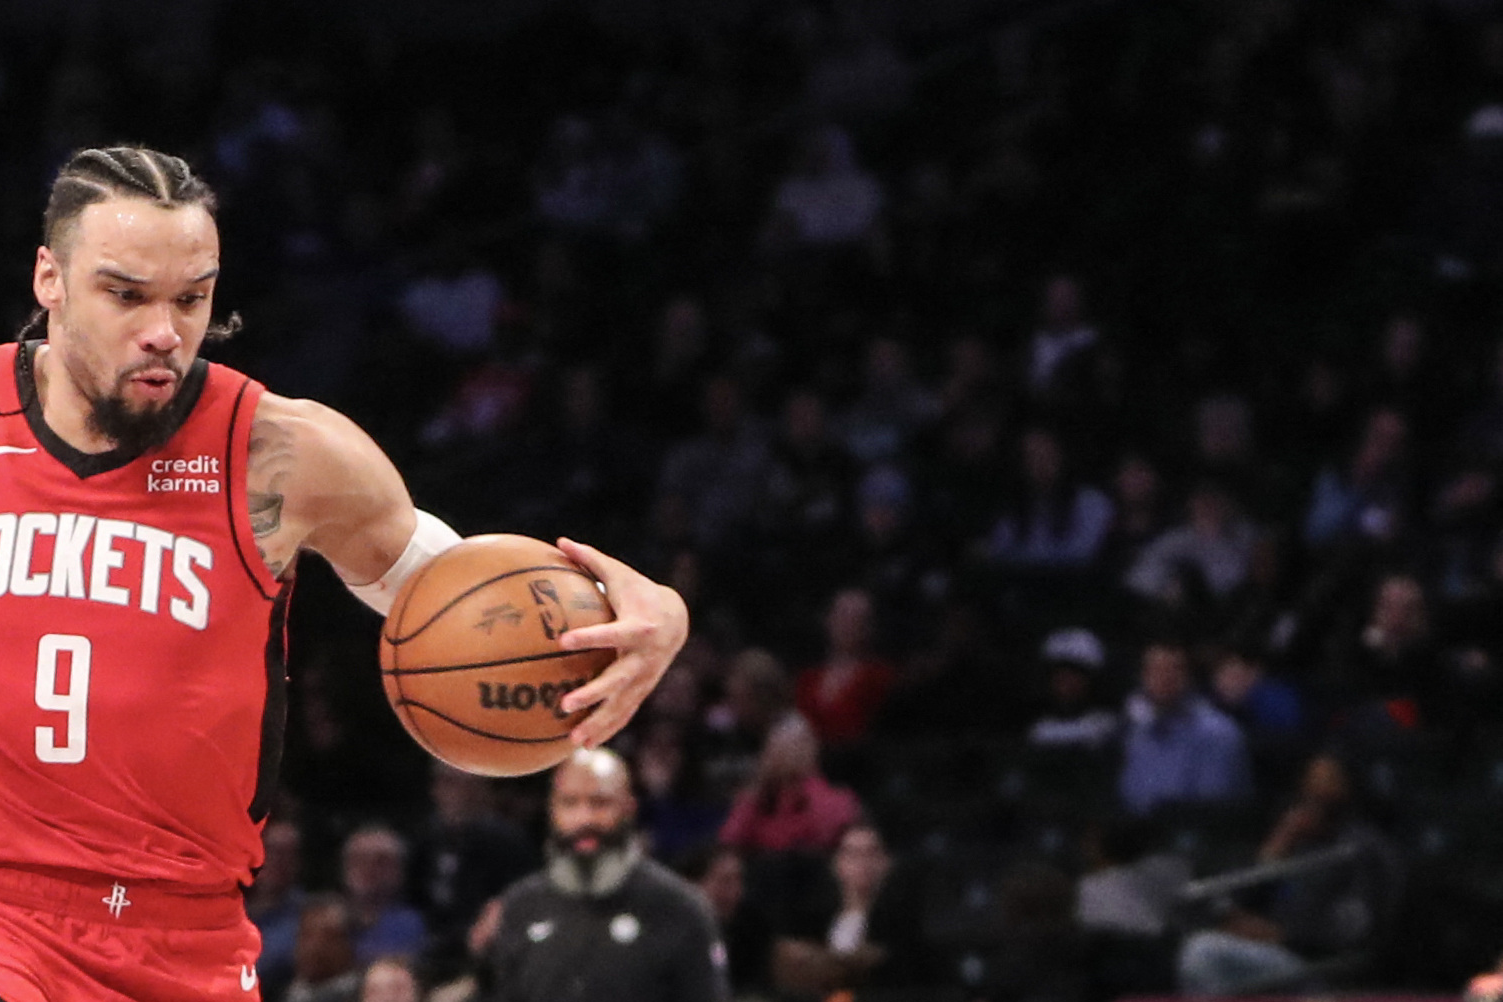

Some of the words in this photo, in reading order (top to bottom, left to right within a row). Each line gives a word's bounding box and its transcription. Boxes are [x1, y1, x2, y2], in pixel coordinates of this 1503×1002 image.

[151, 455, 220, 474] credit
[147, 473, 220, 493] karma
[35, 633, 92, 764] 9
